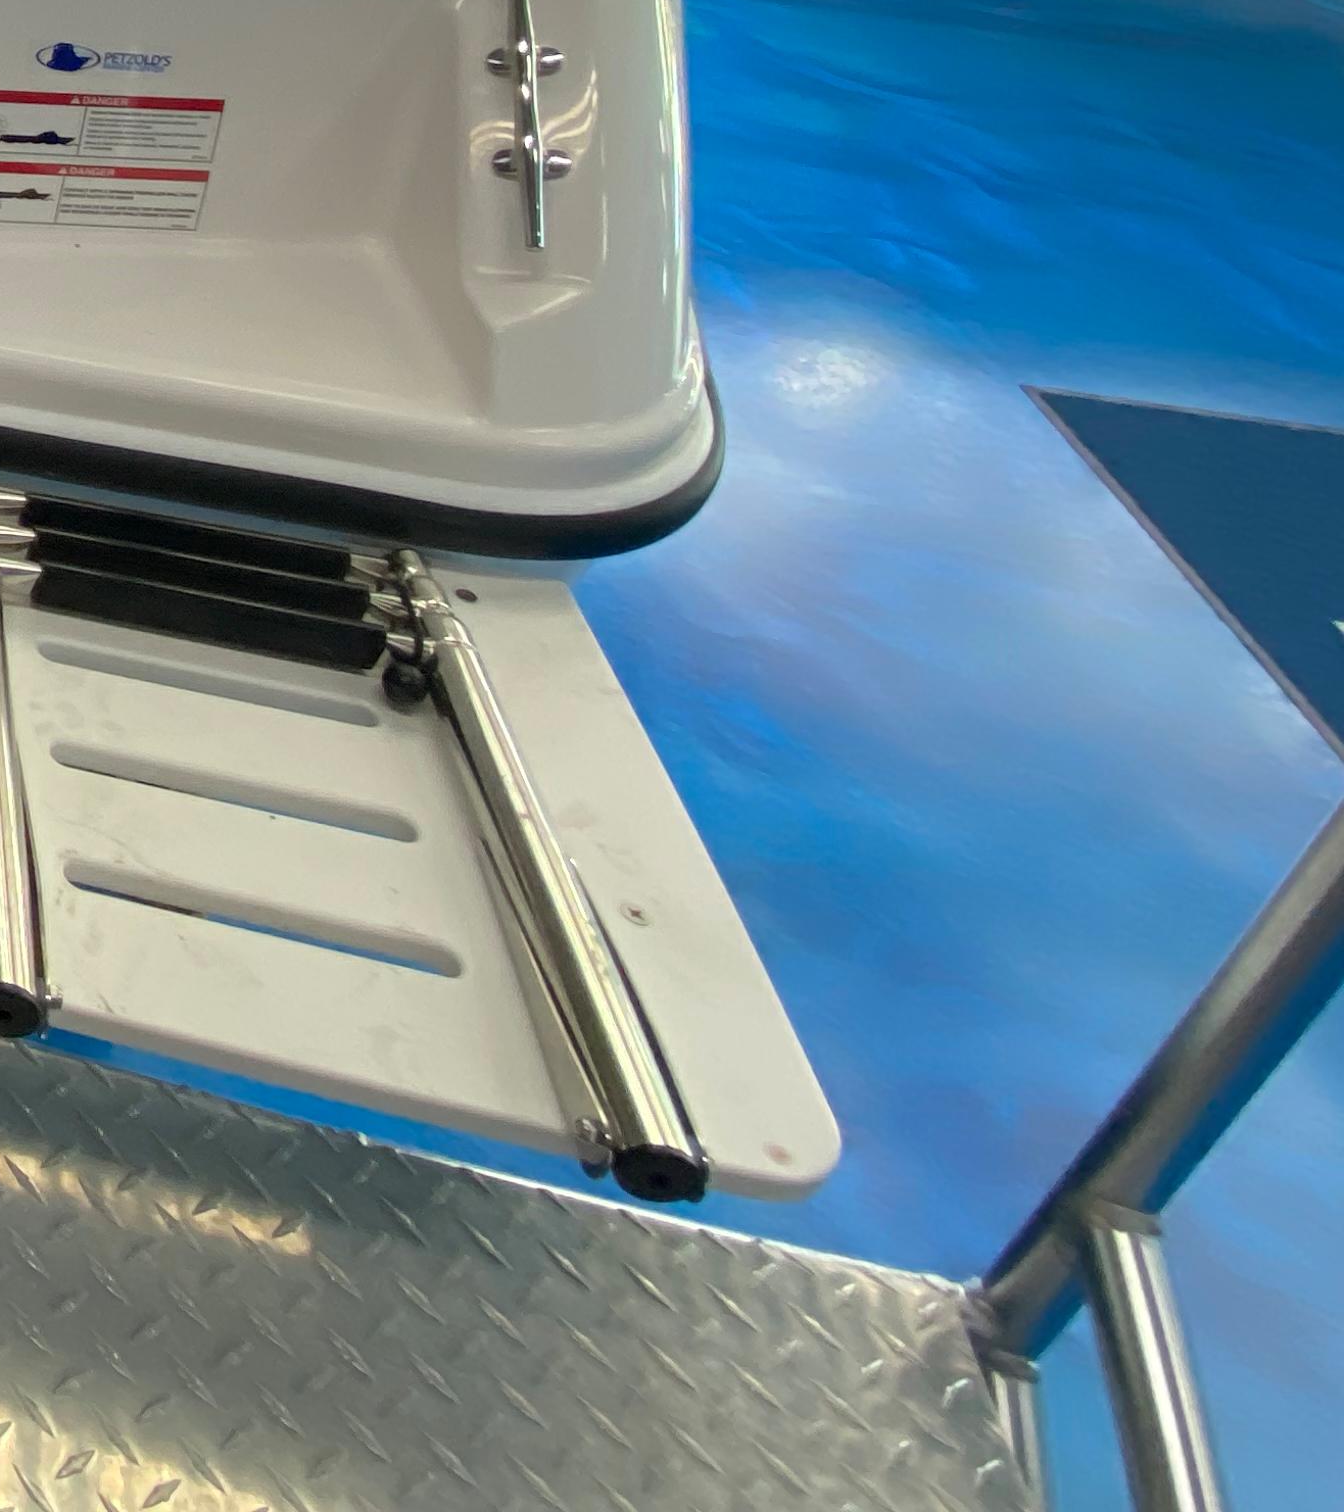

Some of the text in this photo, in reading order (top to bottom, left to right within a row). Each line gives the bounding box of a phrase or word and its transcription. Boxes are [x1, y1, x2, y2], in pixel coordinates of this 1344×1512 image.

[103, 51, 173, 68] PETZOLD'S
[81, 96, 130, 107] DANGER
[68, 166, 116, 177] DANGER
